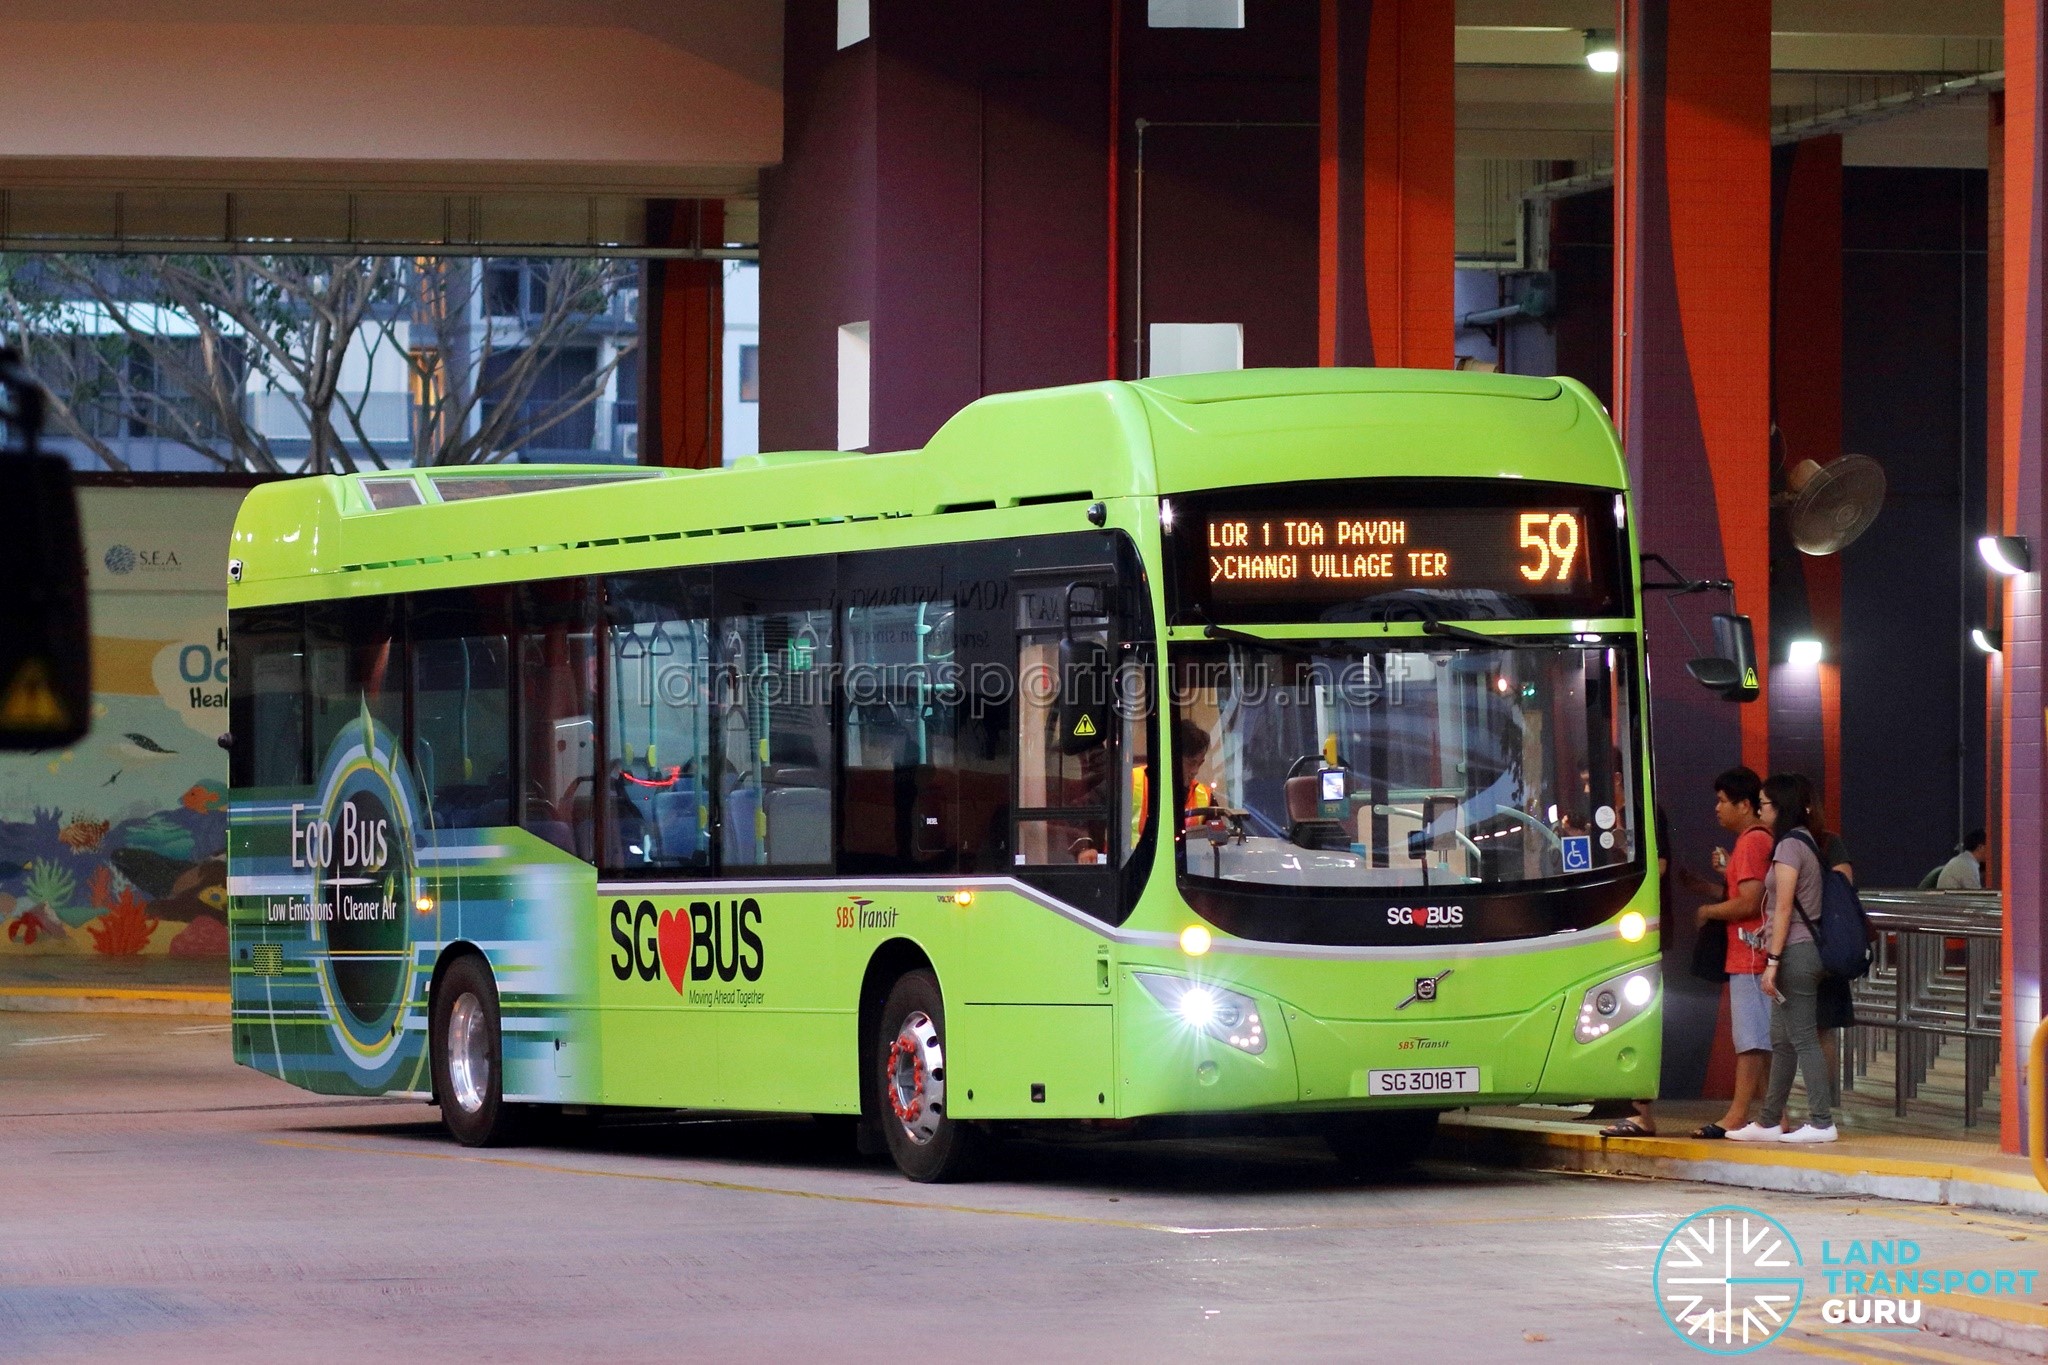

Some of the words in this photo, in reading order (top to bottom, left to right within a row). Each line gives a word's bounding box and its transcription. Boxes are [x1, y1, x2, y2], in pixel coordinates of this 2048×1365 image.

[1210, 522, 1249, 546] LOR
[1262, 522, 1270, 546] 1
[1284, 521, 1324, 546] TOA
[1338, 520, 1405, 545] PAYOH
[1519, 513, 1578, 580] 59
[1311, 554, 1394, 578] VILLAGE
[1408, 553, 1448, 577] TER
[291, 803, 333, 868] Eco
[343, 801, 388, 867] Bus
[267, 897, 286, 921] Low
[288, 896, 333, 921] Emissions
[343, 895, 379, 920] Cleaner
[381, 895, 397, 920] Air
[836, 906, 855, 929] SBS
[853, 900, 900, 933] Transit
[688, 989, 713, 1008] Moving
[714, 988, 735, 1004] Ahead
[736, 988, 765, 1008] Together
[1398, 1041, 1414, 1050] SBS
[1415, 1037, 1451, 1050] Transit
